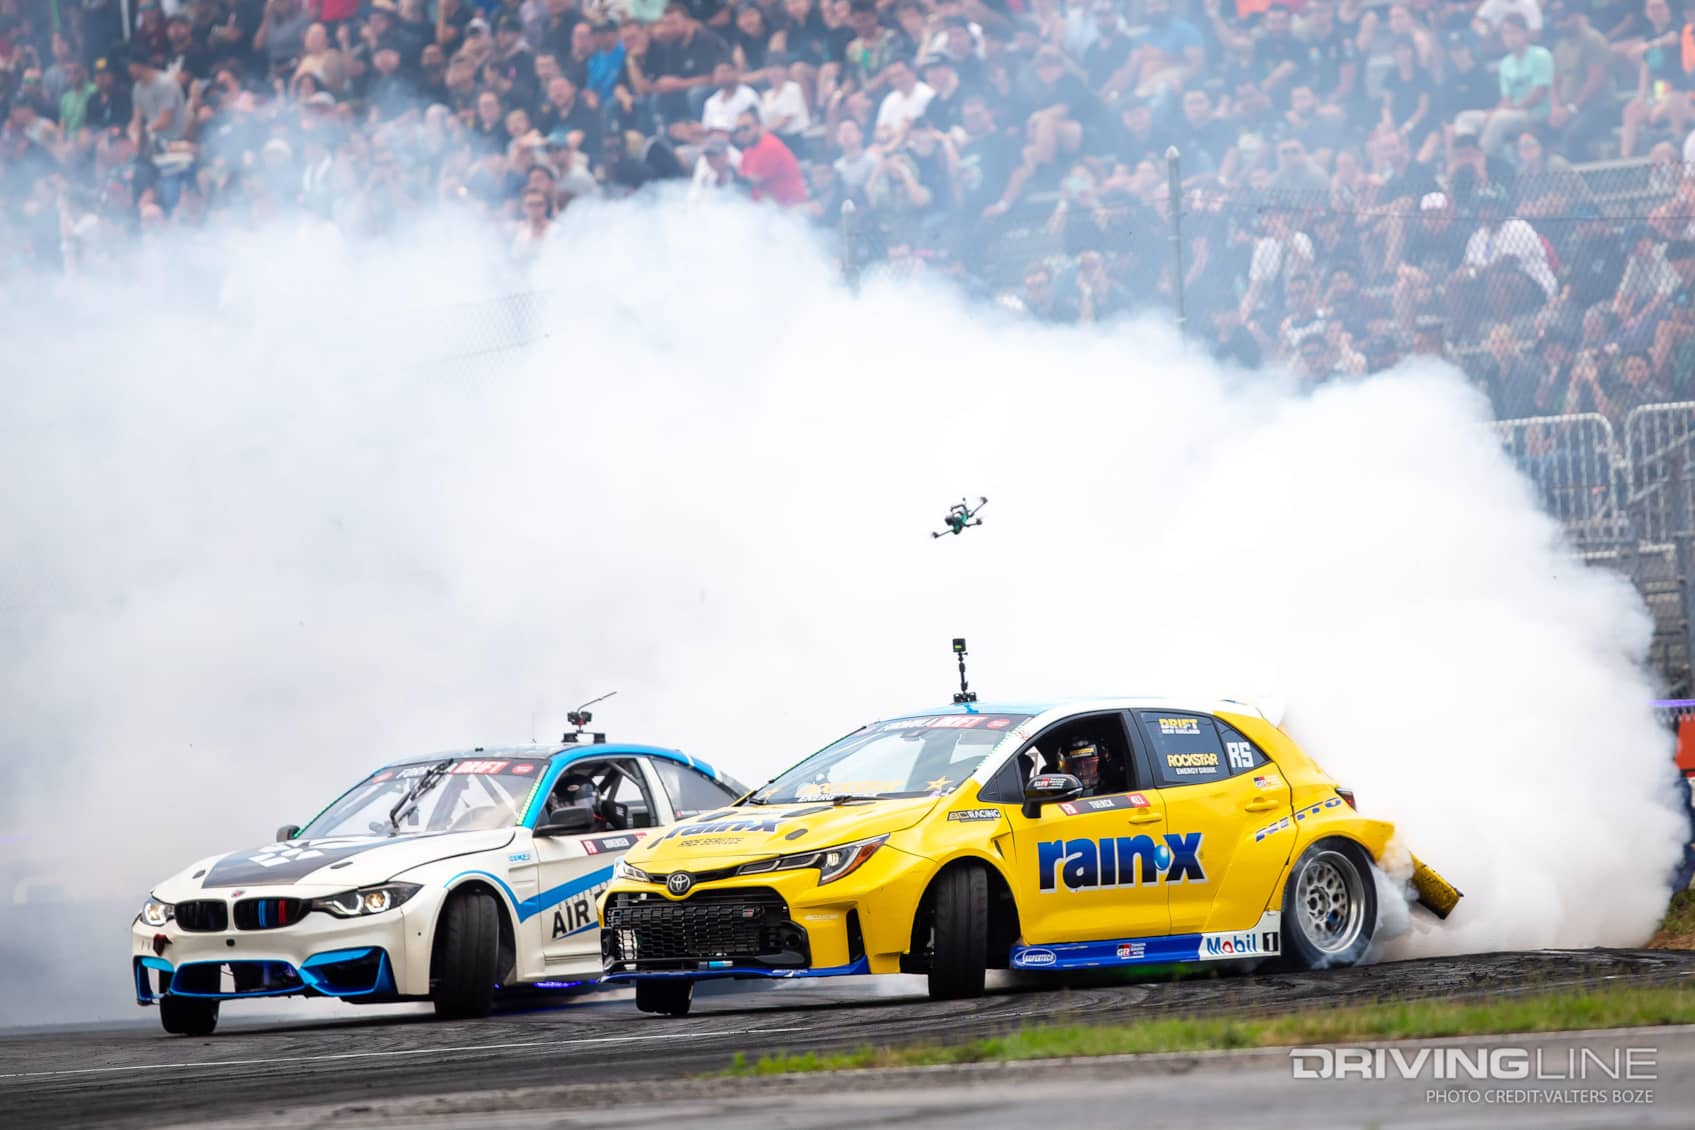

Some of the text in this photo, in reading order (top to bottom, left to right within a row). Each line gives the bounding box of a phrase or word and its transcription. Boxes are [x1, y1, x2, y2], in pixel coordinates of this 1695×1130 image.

[1159, 718, 1198, 729] DRIFT
[1167, 753, 1219, 767] ROCKSTAR
[1226, 742, 1254, 768] RS
[1176, 767, 1198, 775] ENERGY
[552, 900, 591, 939] AIR
[1206, 933, 1258, 955] Mobil
